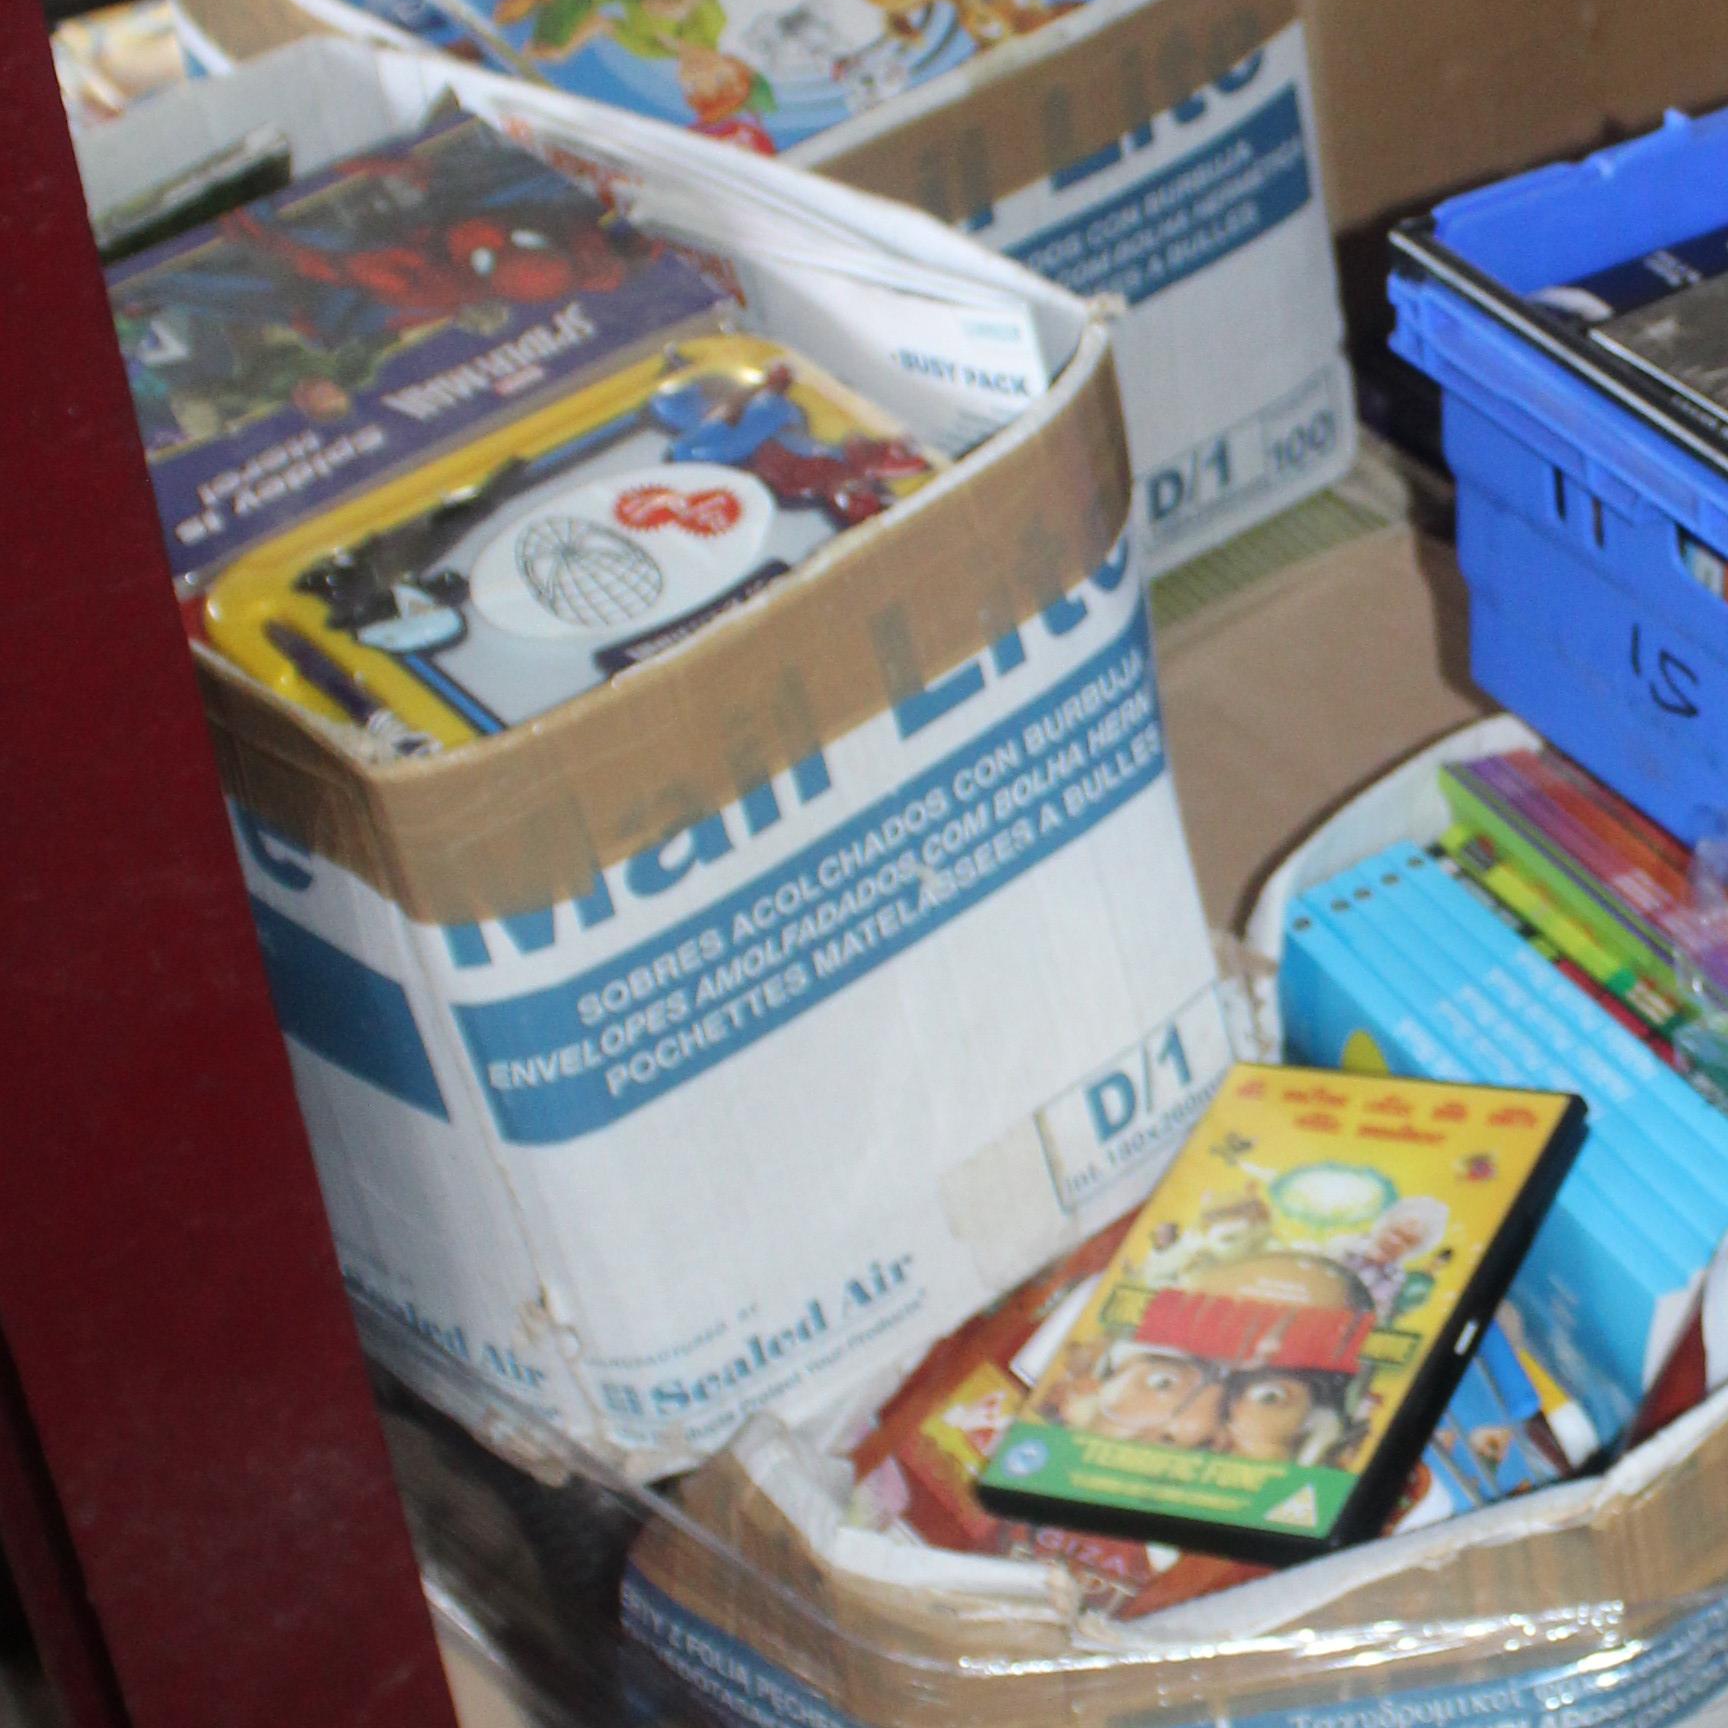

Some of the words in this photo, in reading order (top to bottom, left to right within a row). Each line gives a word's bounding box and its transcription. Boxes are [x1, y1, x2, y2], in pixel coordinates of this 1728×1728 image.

[960, 365, 1028, 397] PACK
[488, 986, 691, 1091] ENVELOPES
[694, 858, 915, 1006] AMOLFADADOS
[919, 810, 989, 874] COM
[992, 748, 1087, 820] BOLHA
[577, 930, 724, 1027] SOBRES
[731, 789, 948, 945] ACOLCHADOS
[952, 743, 1020, 808] CON
[1024, 650, 1145, 754] BURBUJA
[604, 964, 809, 1096] POCHETTES
[1035, 800, 1063, 839] A
[1067, 726, 1165, 818] BULLES
[1084, 1022, 1193, 1146] D/1
[650, 1296, 828, 1416] Sealed
[842, 1253, 913, 1319] Air
[1035, 1527, 1125, 1574] GIZA
